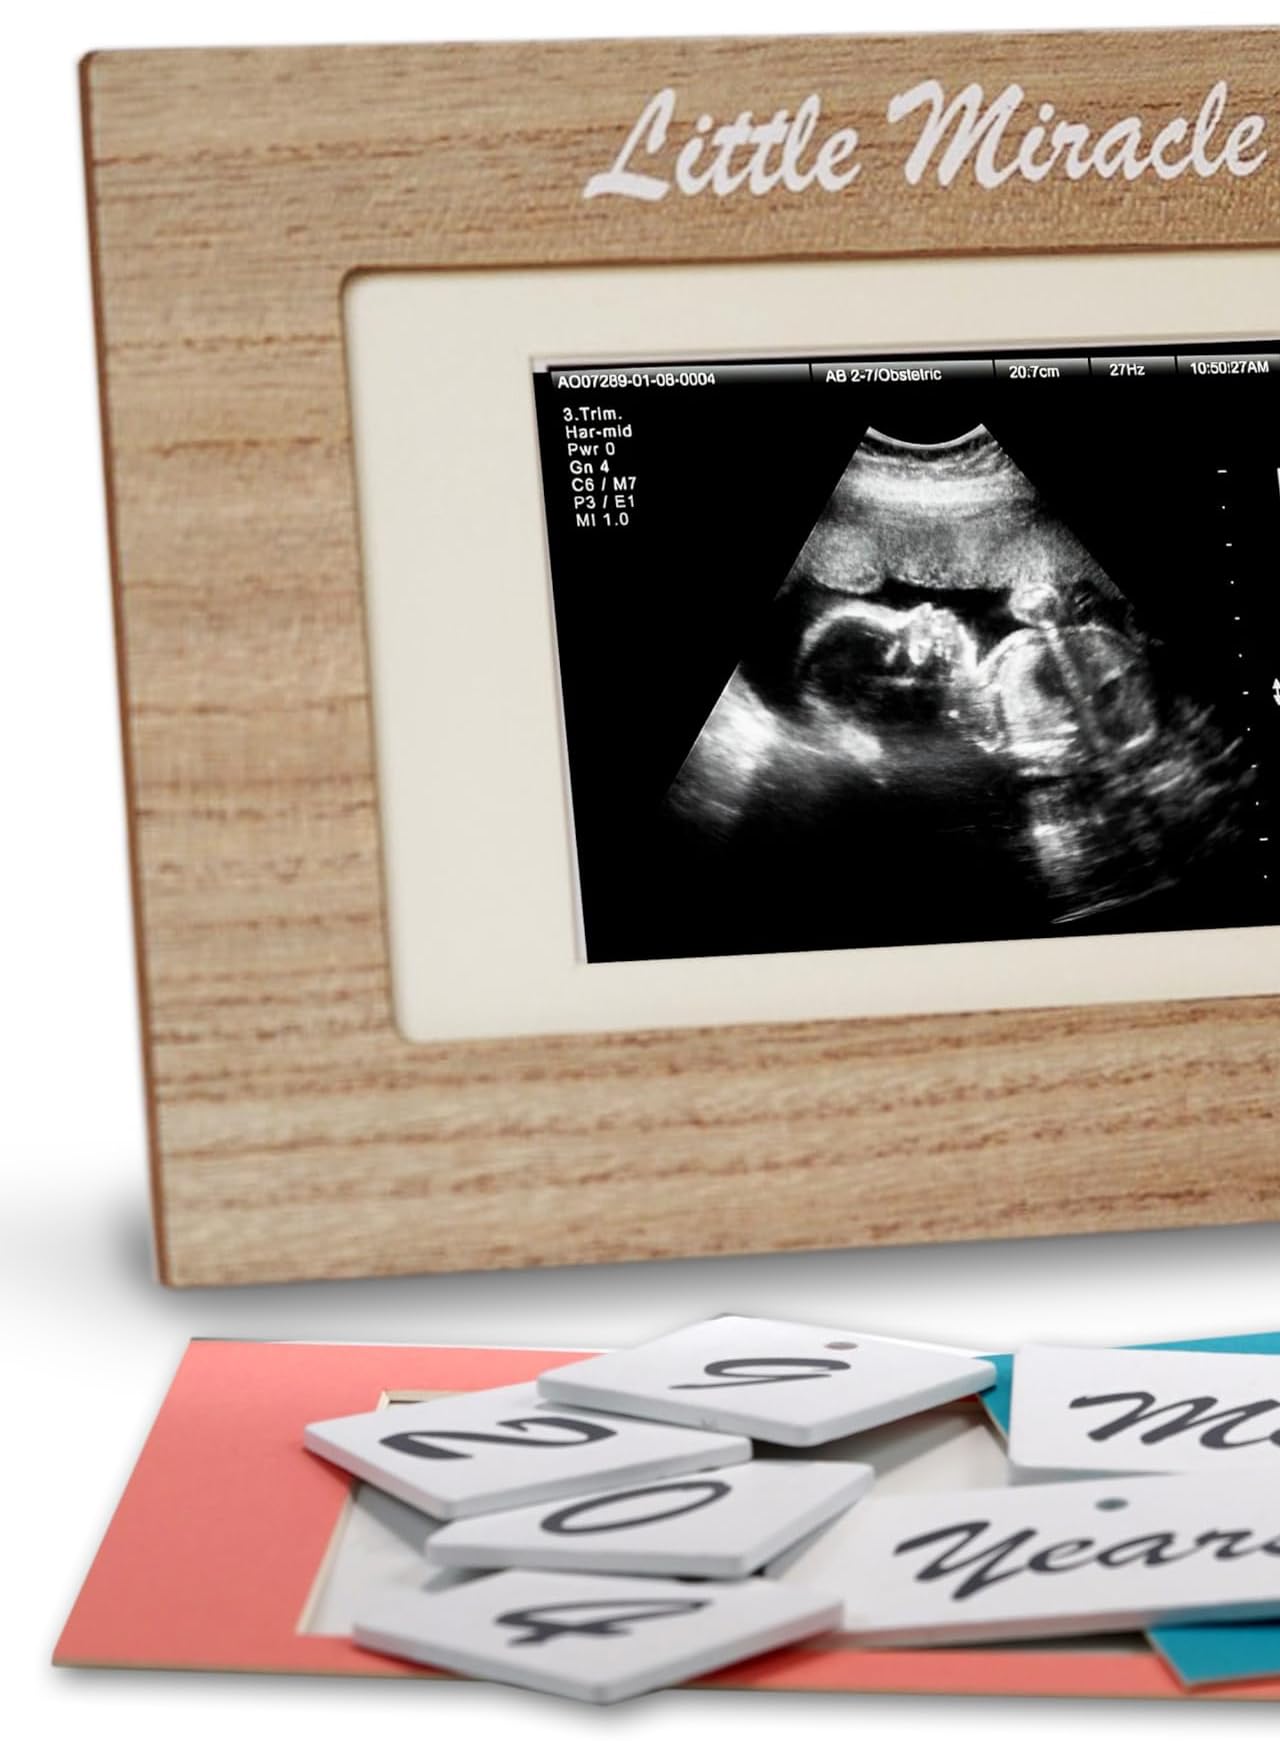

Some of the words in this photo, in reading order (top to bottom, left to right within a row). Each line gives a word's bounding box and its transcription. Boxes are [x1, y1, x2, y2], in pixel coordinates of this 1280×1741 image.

[583, 87, 863, 201] Little
[885, 79, 1268, 189] Miracle
[825, 369, 848, 383] AB
[1109, 363, 1146, 377] 27Hz
[565, 423, 633, 439] Har-mid
[567, 442, 600, 456] Pwr
[605, 441, 616, 456] 0
[569, 460, 594, 475] Gn
[600, 459, 610, 474] 4
[571, 477, 595, 492] C6
[612, 476, 637, 491] M7
[573, 495, 597, 510] P3
[614, 494, 635, 508] E1
[575, 513, 596, 527] MI
[602, 511, 629, 526] 1.0
